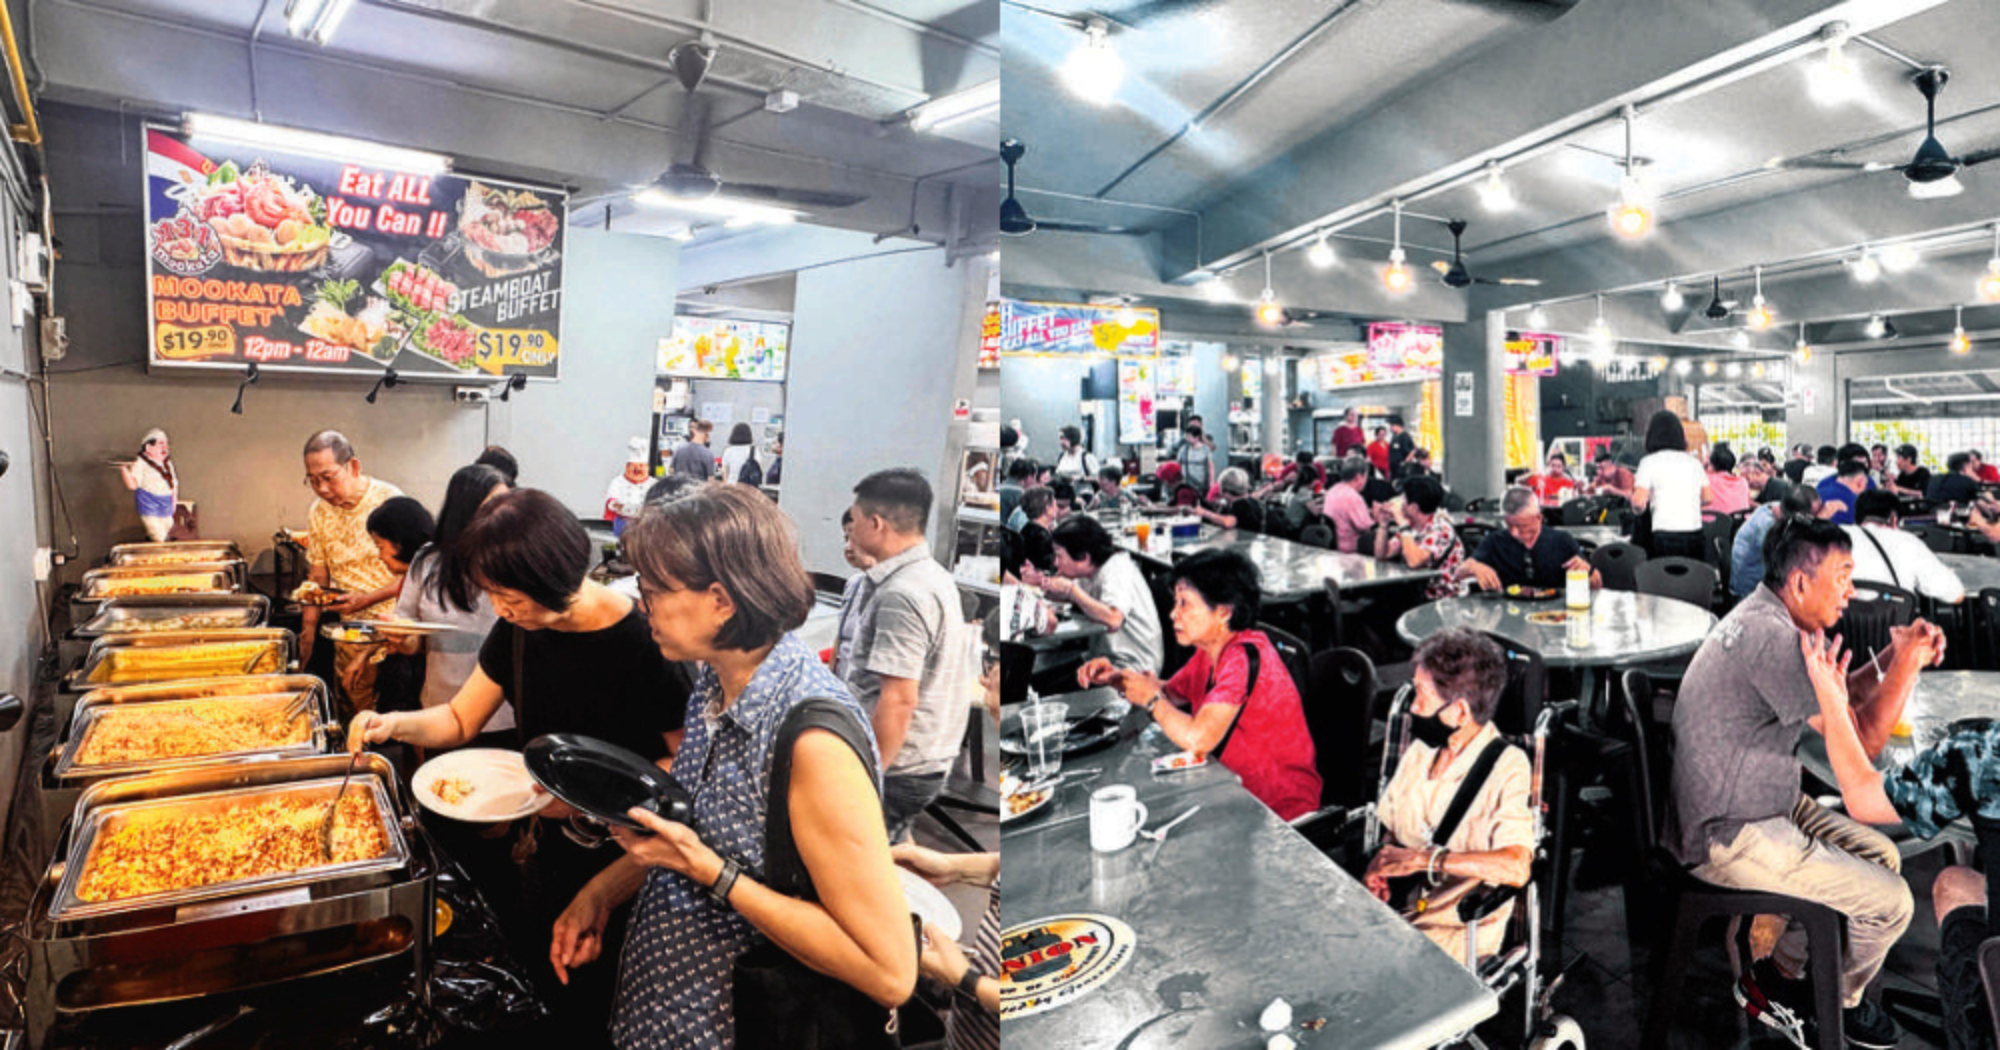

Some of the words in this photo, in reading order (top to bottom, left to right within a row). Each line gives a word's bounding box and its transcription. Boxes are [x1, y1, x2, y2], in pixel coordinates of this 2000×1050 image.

[340, 165, 384, 198] Eat
[388, 172, 431, 206] ALL
[327, 196, 372, 230] You
[375, 204, 422, 235] Can
[426, 211, 448, 239] !!
[153, 274, 303, 306] MOOKATA
[447, 271, 552, 315] STEAMBOAT
[497, 288, 562, 322] BUFFET
[155, 300, 275, 328] BUFFET
[244, 337, 291, 361] 12pm
[305, 339, 351, 361] 12am
[521, 349, 555, 365] ONLY
